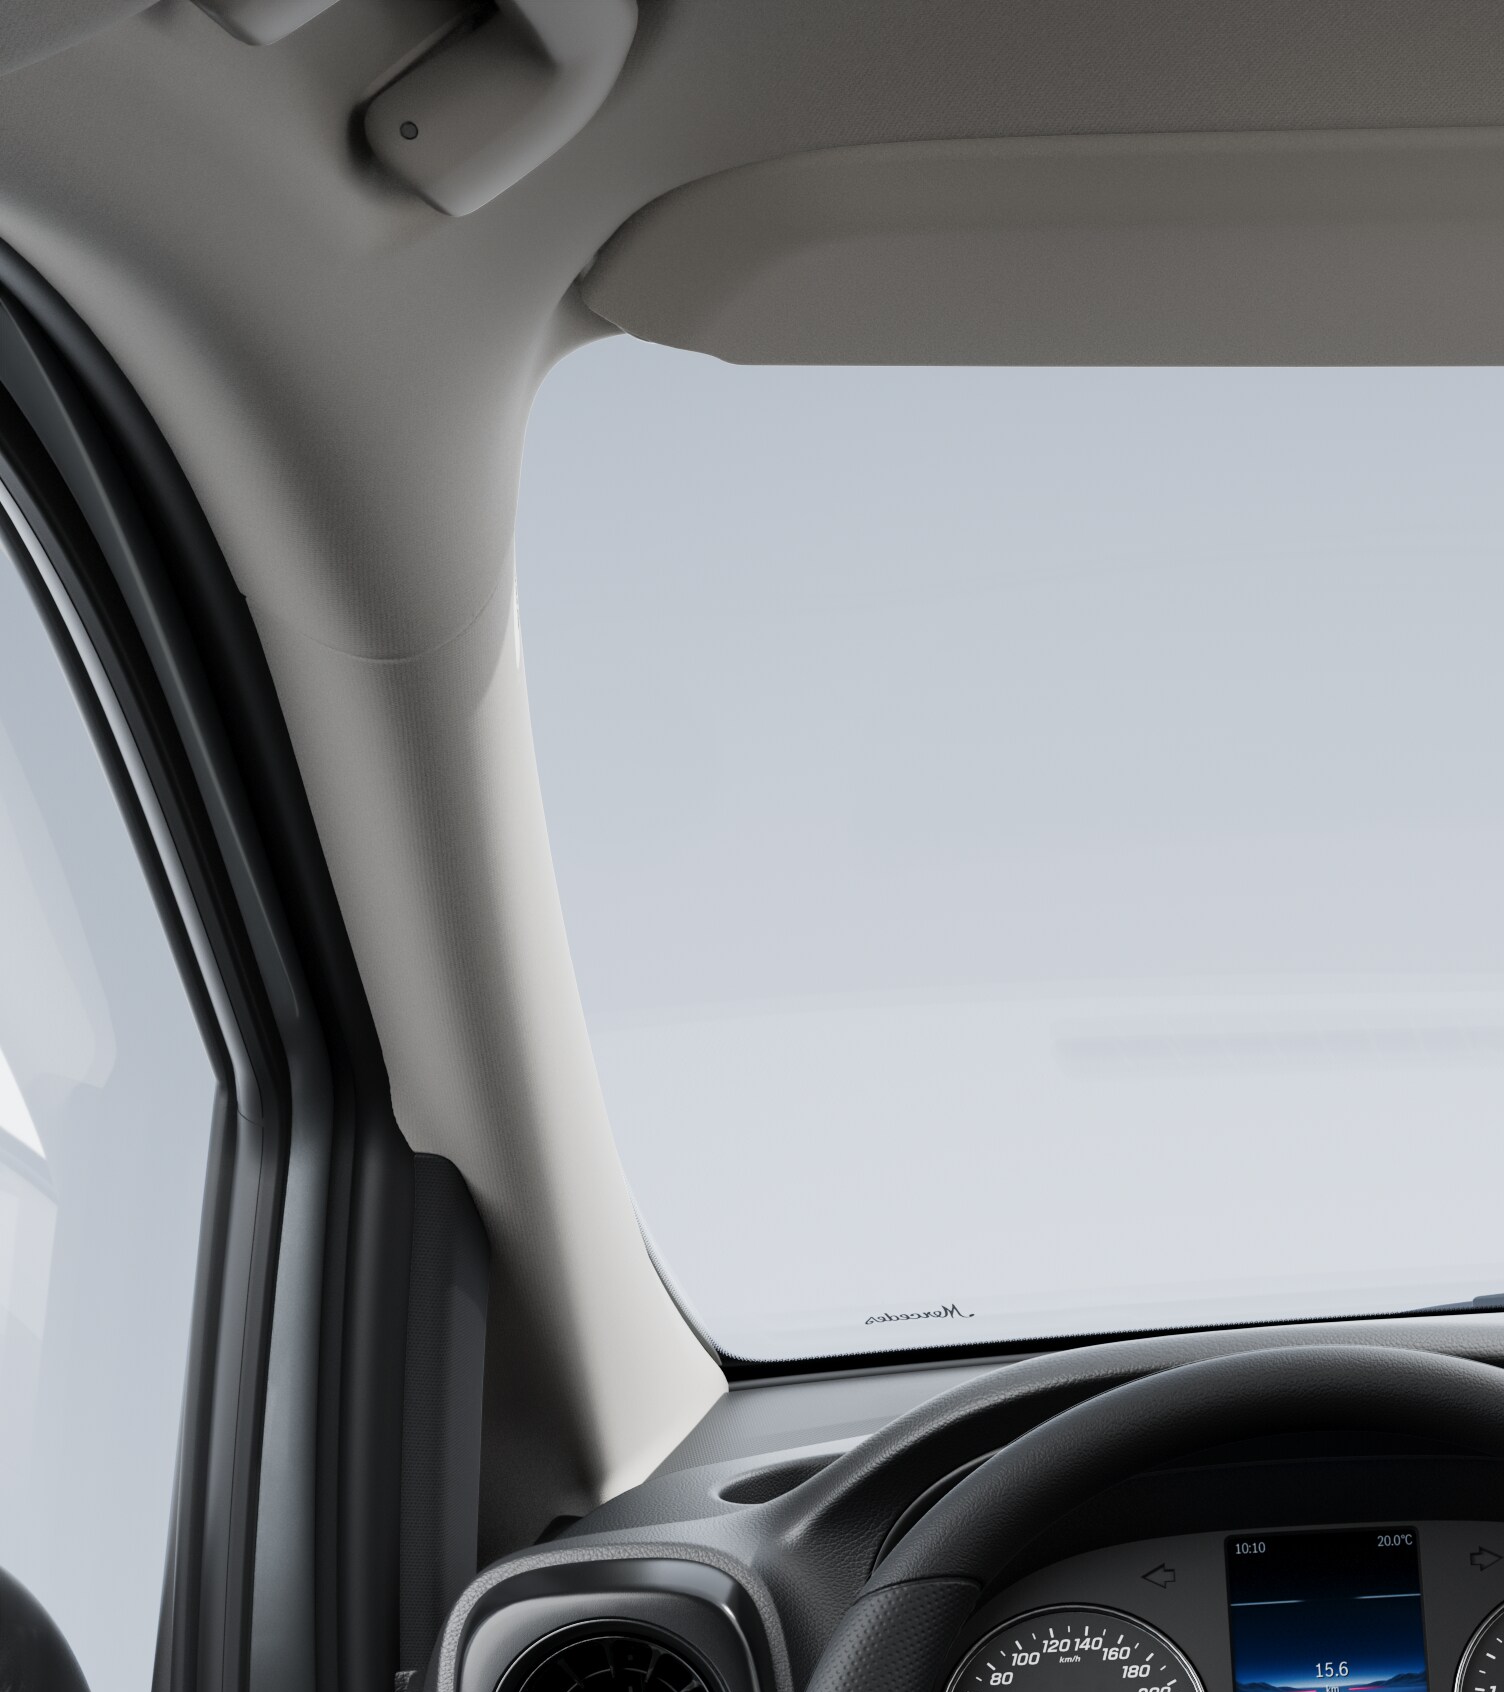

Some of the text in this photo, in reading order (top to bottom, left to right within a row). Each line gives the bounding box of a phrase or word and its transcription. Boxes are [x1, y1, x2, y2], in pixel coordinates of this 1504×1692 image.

[1235, 1541, 1266, 1556] 10:10
[1042, 1638, 1071, 1653] 120
[1074, 1637, 1103, 1652] 140
[1012, 1651, 1040, 1666] 100
[1059, 1655, 1081, 1664] km/h
[1102, 1646, 1131, 1661] 160
[1122, 1664, 1150, 1679] 180
[1315, 1662, 1350, 1679] 15.6
[990, 1672, 1014, 1686] 80
